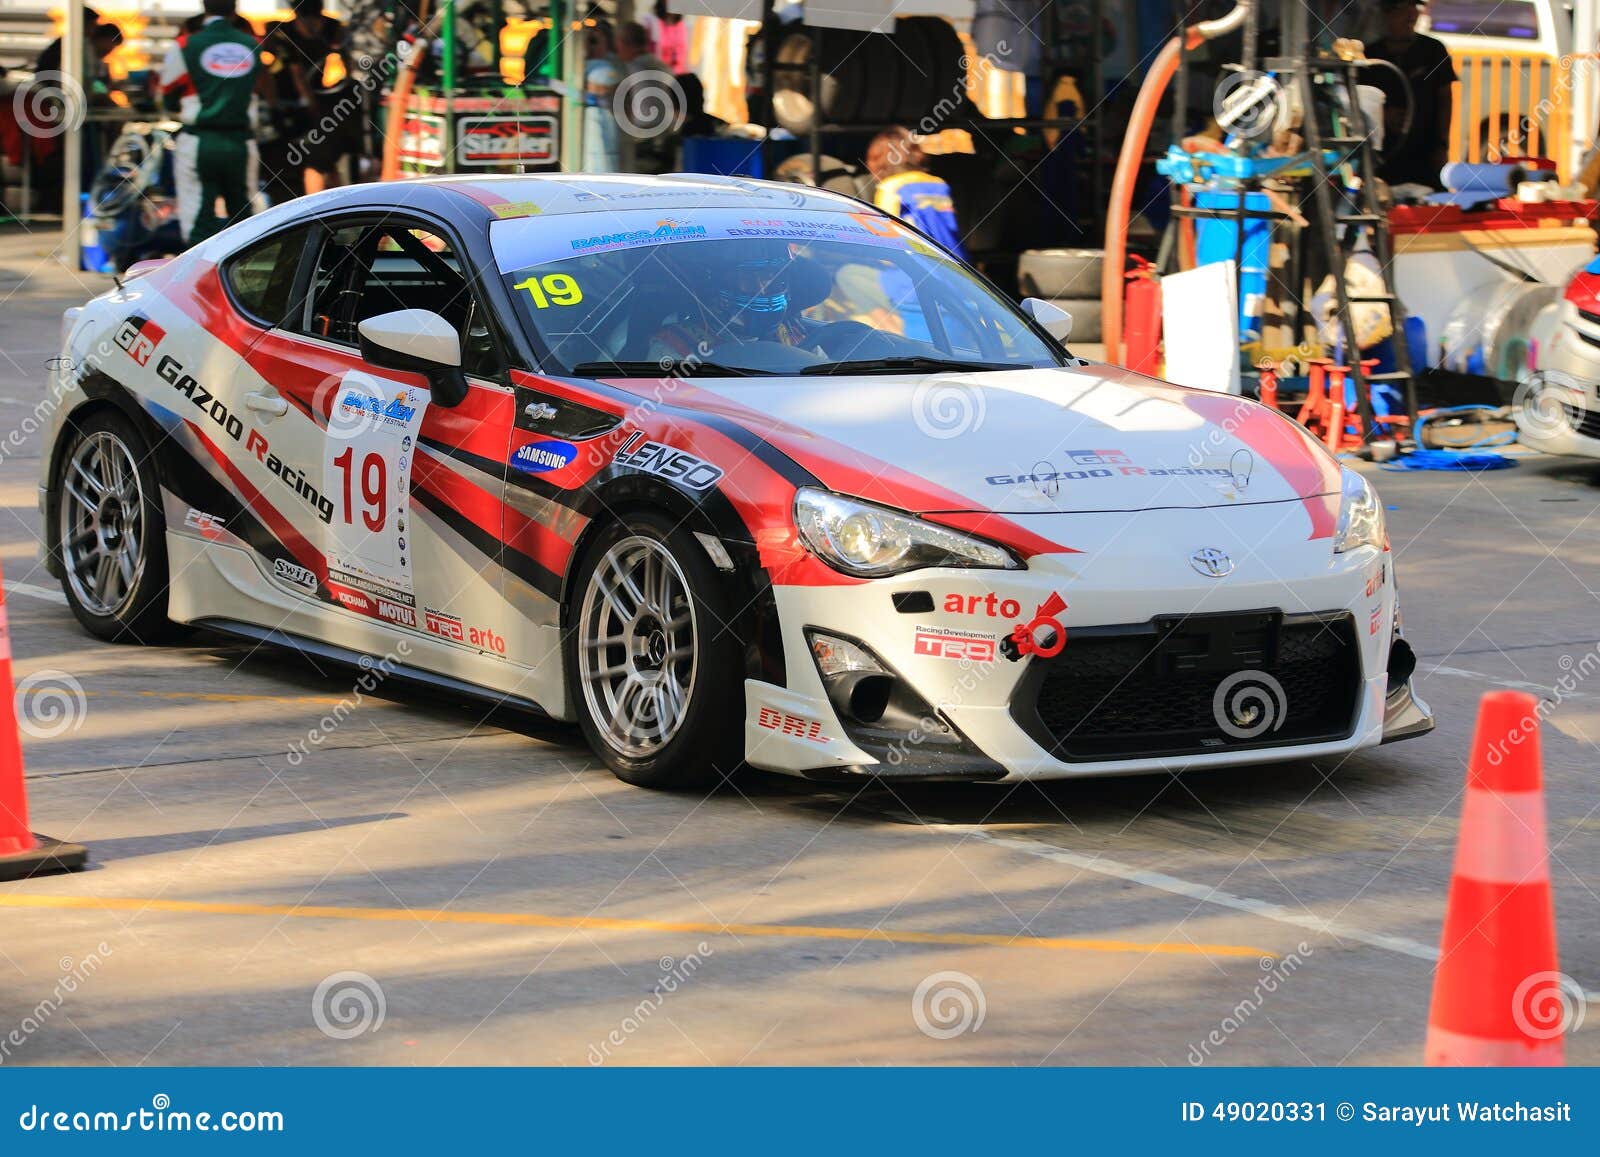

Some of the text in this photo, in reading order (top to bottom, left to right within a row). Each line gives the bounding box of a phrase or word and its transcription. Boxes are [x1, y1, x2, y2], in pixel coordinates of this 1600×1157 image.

[513, 273, 583, 309] 19
[114, 317, 165, 366] GR
[156, 354, 335, 524] GAZOO Racing
[518, 445, 566, 469] SAMSUNG
[613, 431, 723, 488] LENSO
[334, 447, 386, 532] 19
[985, 466, 1233, 486] GAZOO Racing
[275, 559, 317, 585] Swift
[338, 591, 368, 610] YOKOHAMA
[379, 601, 415, 626] MOTUL
[943, 592, 1021, 619] arto
[469, 626, 506, 654] arto
[915, 625, 996, 640] Racing Development
[758, 707, 831, 744] DRL
